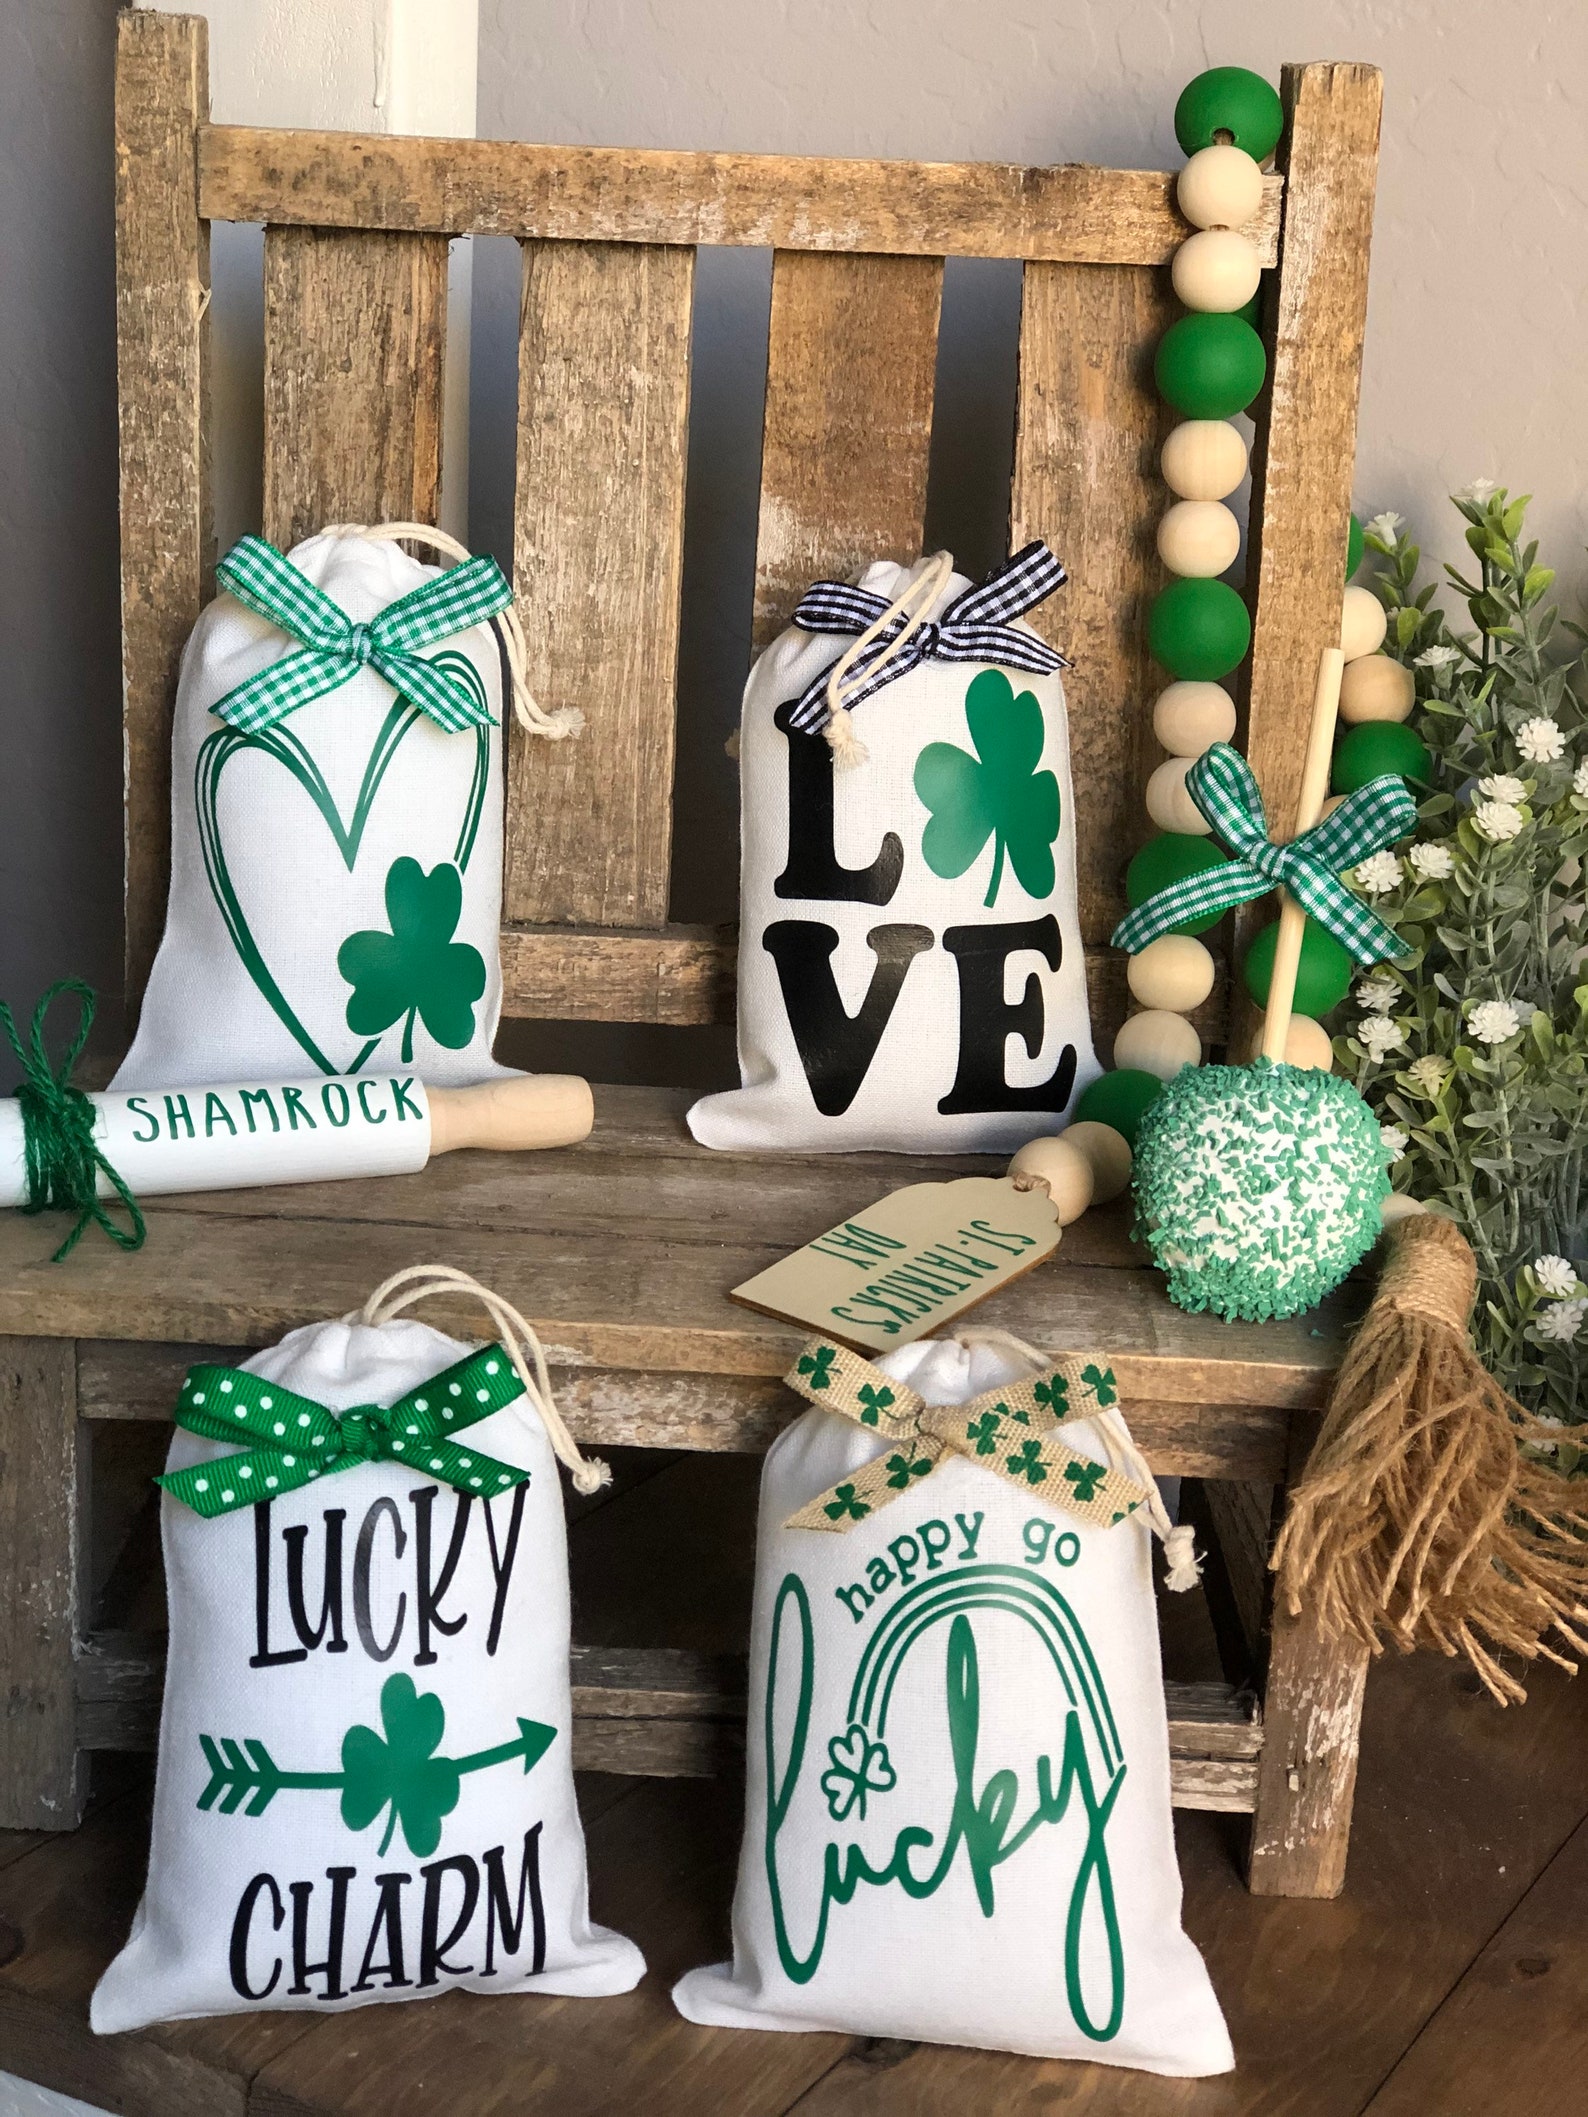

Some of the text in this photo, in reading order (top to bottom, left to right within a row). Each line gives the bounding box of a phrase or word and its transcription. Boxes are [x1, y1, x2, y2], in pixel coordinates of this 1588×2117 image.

[126, 1076, 425, 1143] SHAMROCK
[808, 1222, 907, 1271] DAY
[835, 1511, 1081, 1623] happy go
[765, 1573, 1127, 2042] lucky
[229, 1820, 548, 2001] CHARM
